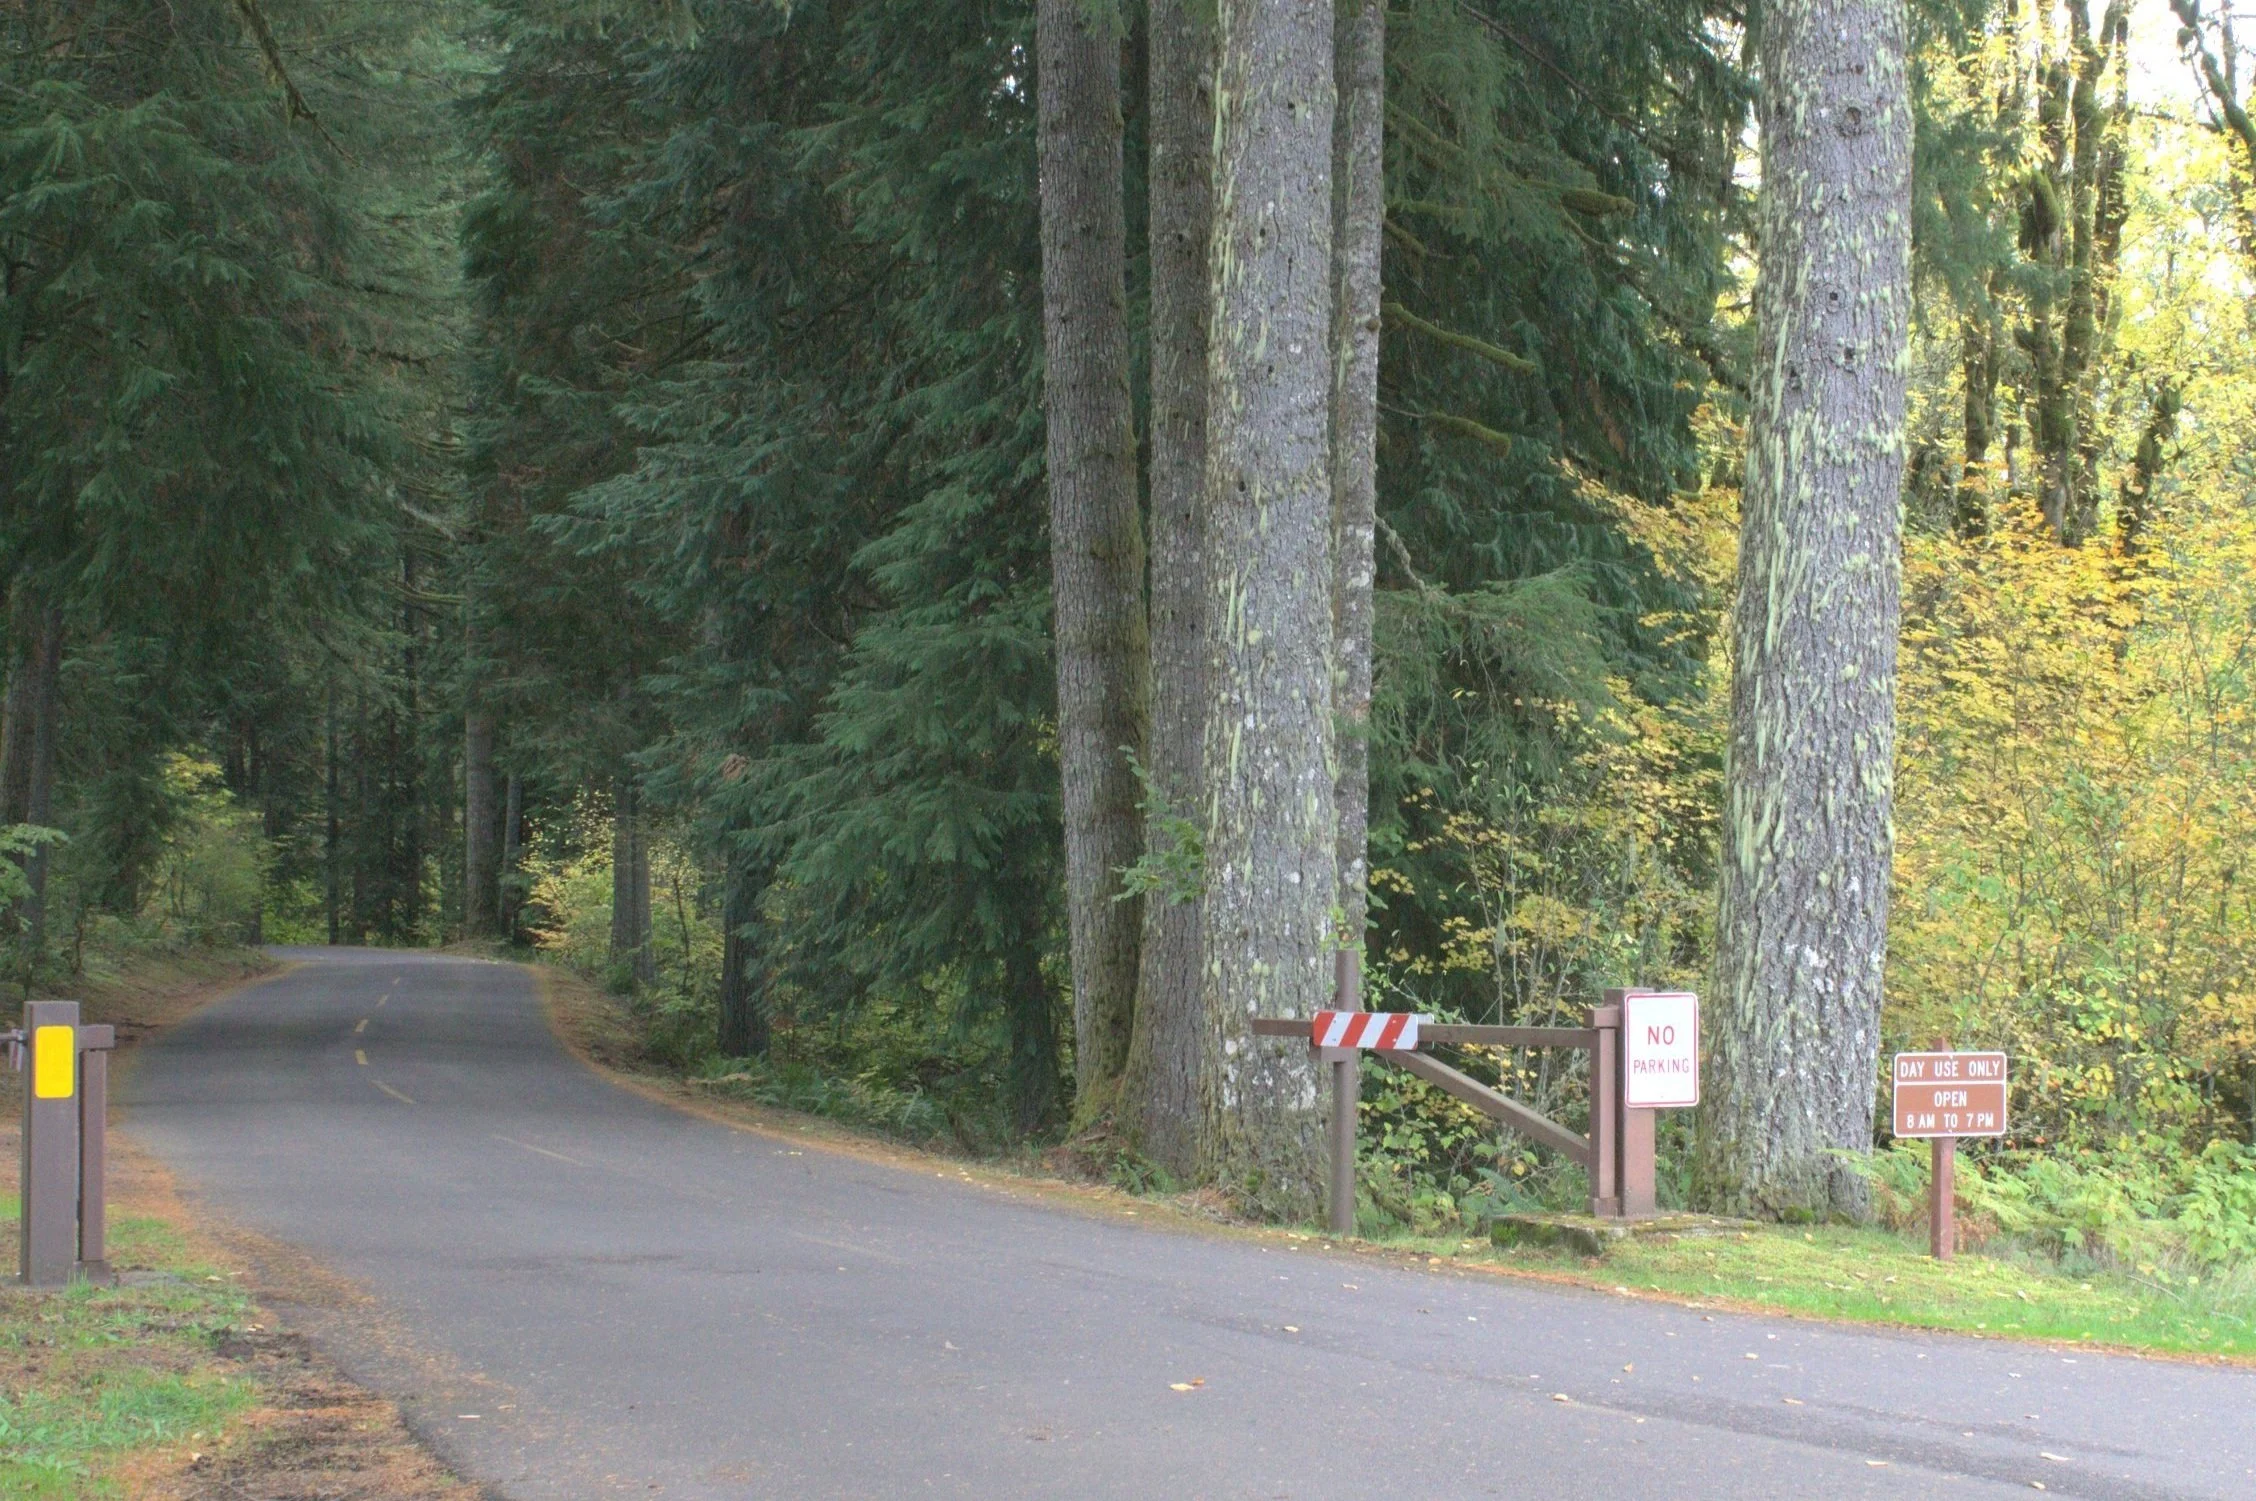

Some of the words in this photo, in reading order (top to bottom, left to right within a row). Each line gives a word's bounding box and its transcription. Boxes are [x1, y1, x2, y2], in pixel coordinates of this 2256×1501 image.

[1647, 1025, 1675, 1046] NO
[1633, 1058, 1690, 1074] PARKING
[1900, 1061, 1925, 1077] DAY
[1934, 1061, 1959, 1077] USE
[1968, 1060, 2000, 1076] ONLY
[1934, 1090, 1967, 1107] OPEN
[1906, 1114, 1914, 1128] 8
[1918, 1113, 1935, 1128] AM
[1943, 1113, 1958, 1128] TO
[1966, 1112, 1974, 1127] 7
[1977, 1112, 1994, 1127] PM
